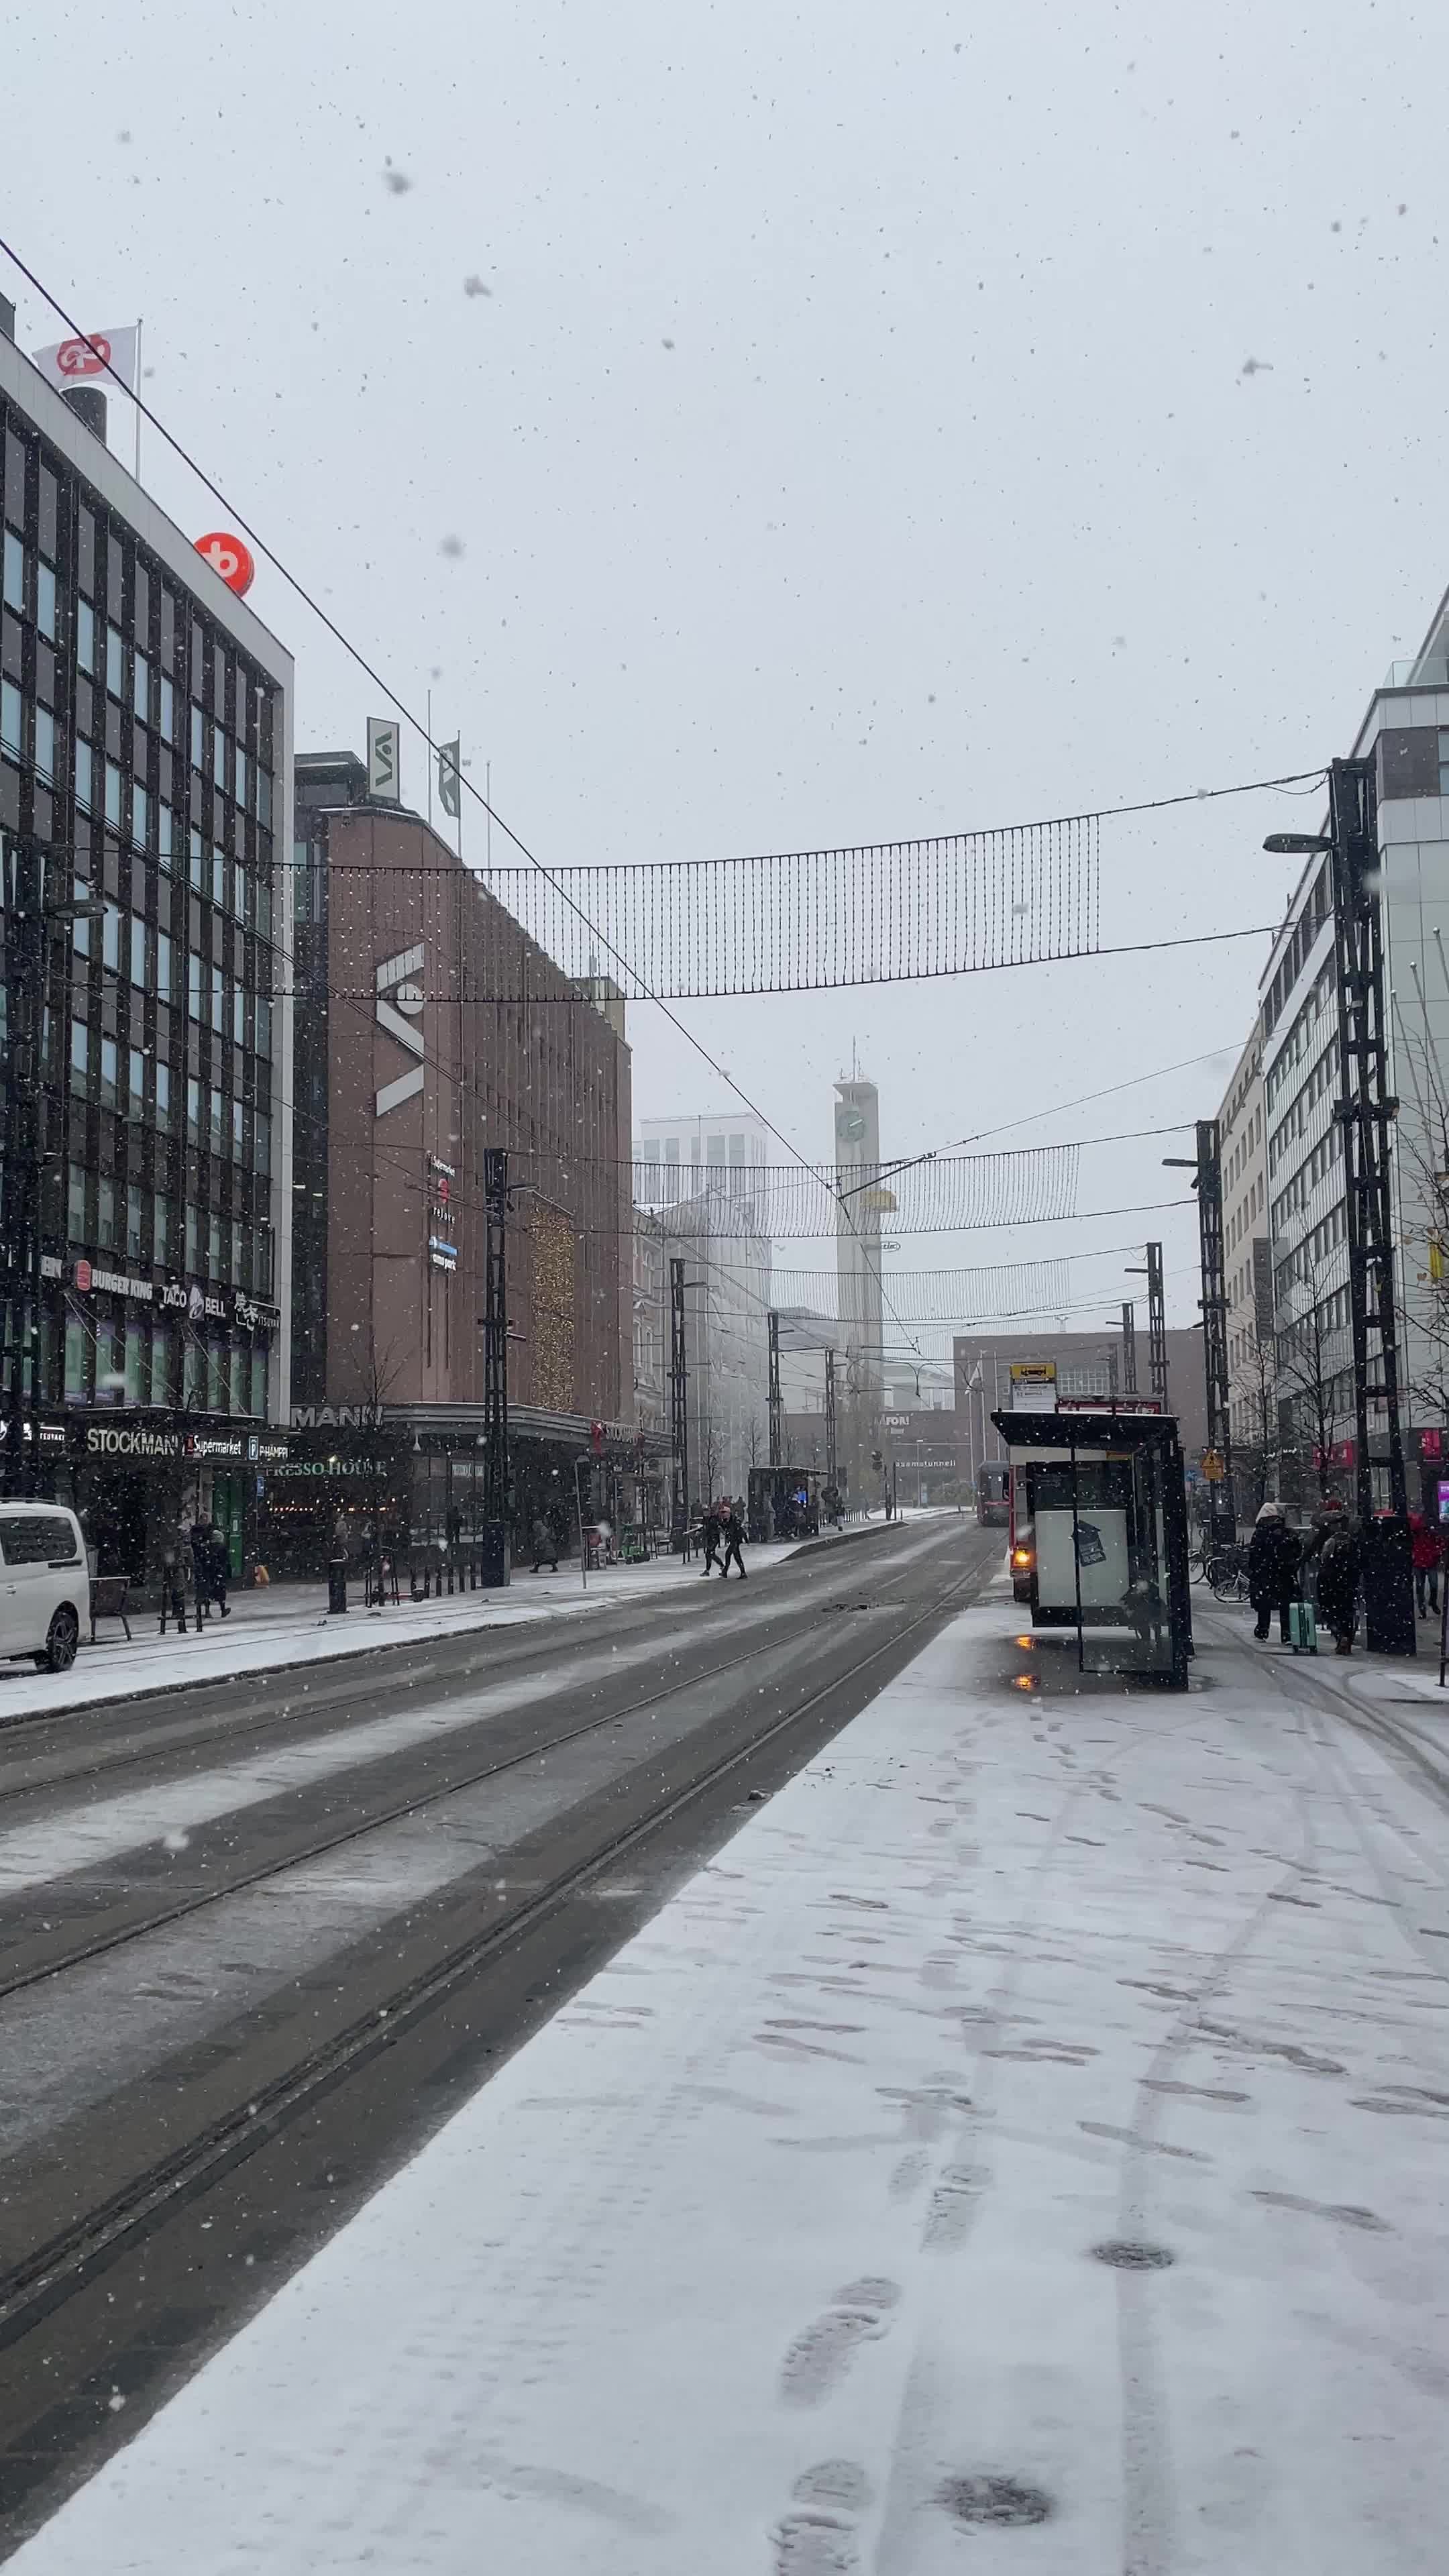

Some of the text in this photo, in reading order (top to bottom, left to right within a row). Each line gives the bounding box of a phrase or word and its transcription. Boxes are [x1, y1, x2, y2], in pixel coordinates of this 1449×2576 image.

[91, 1269, 129, 1295] BURGER
[162, 1285, 226, 1318] TACO BELL
[193, 1434, 241, 1456] Supermarket
[328, 1460, 387, 1477] HOUSE
